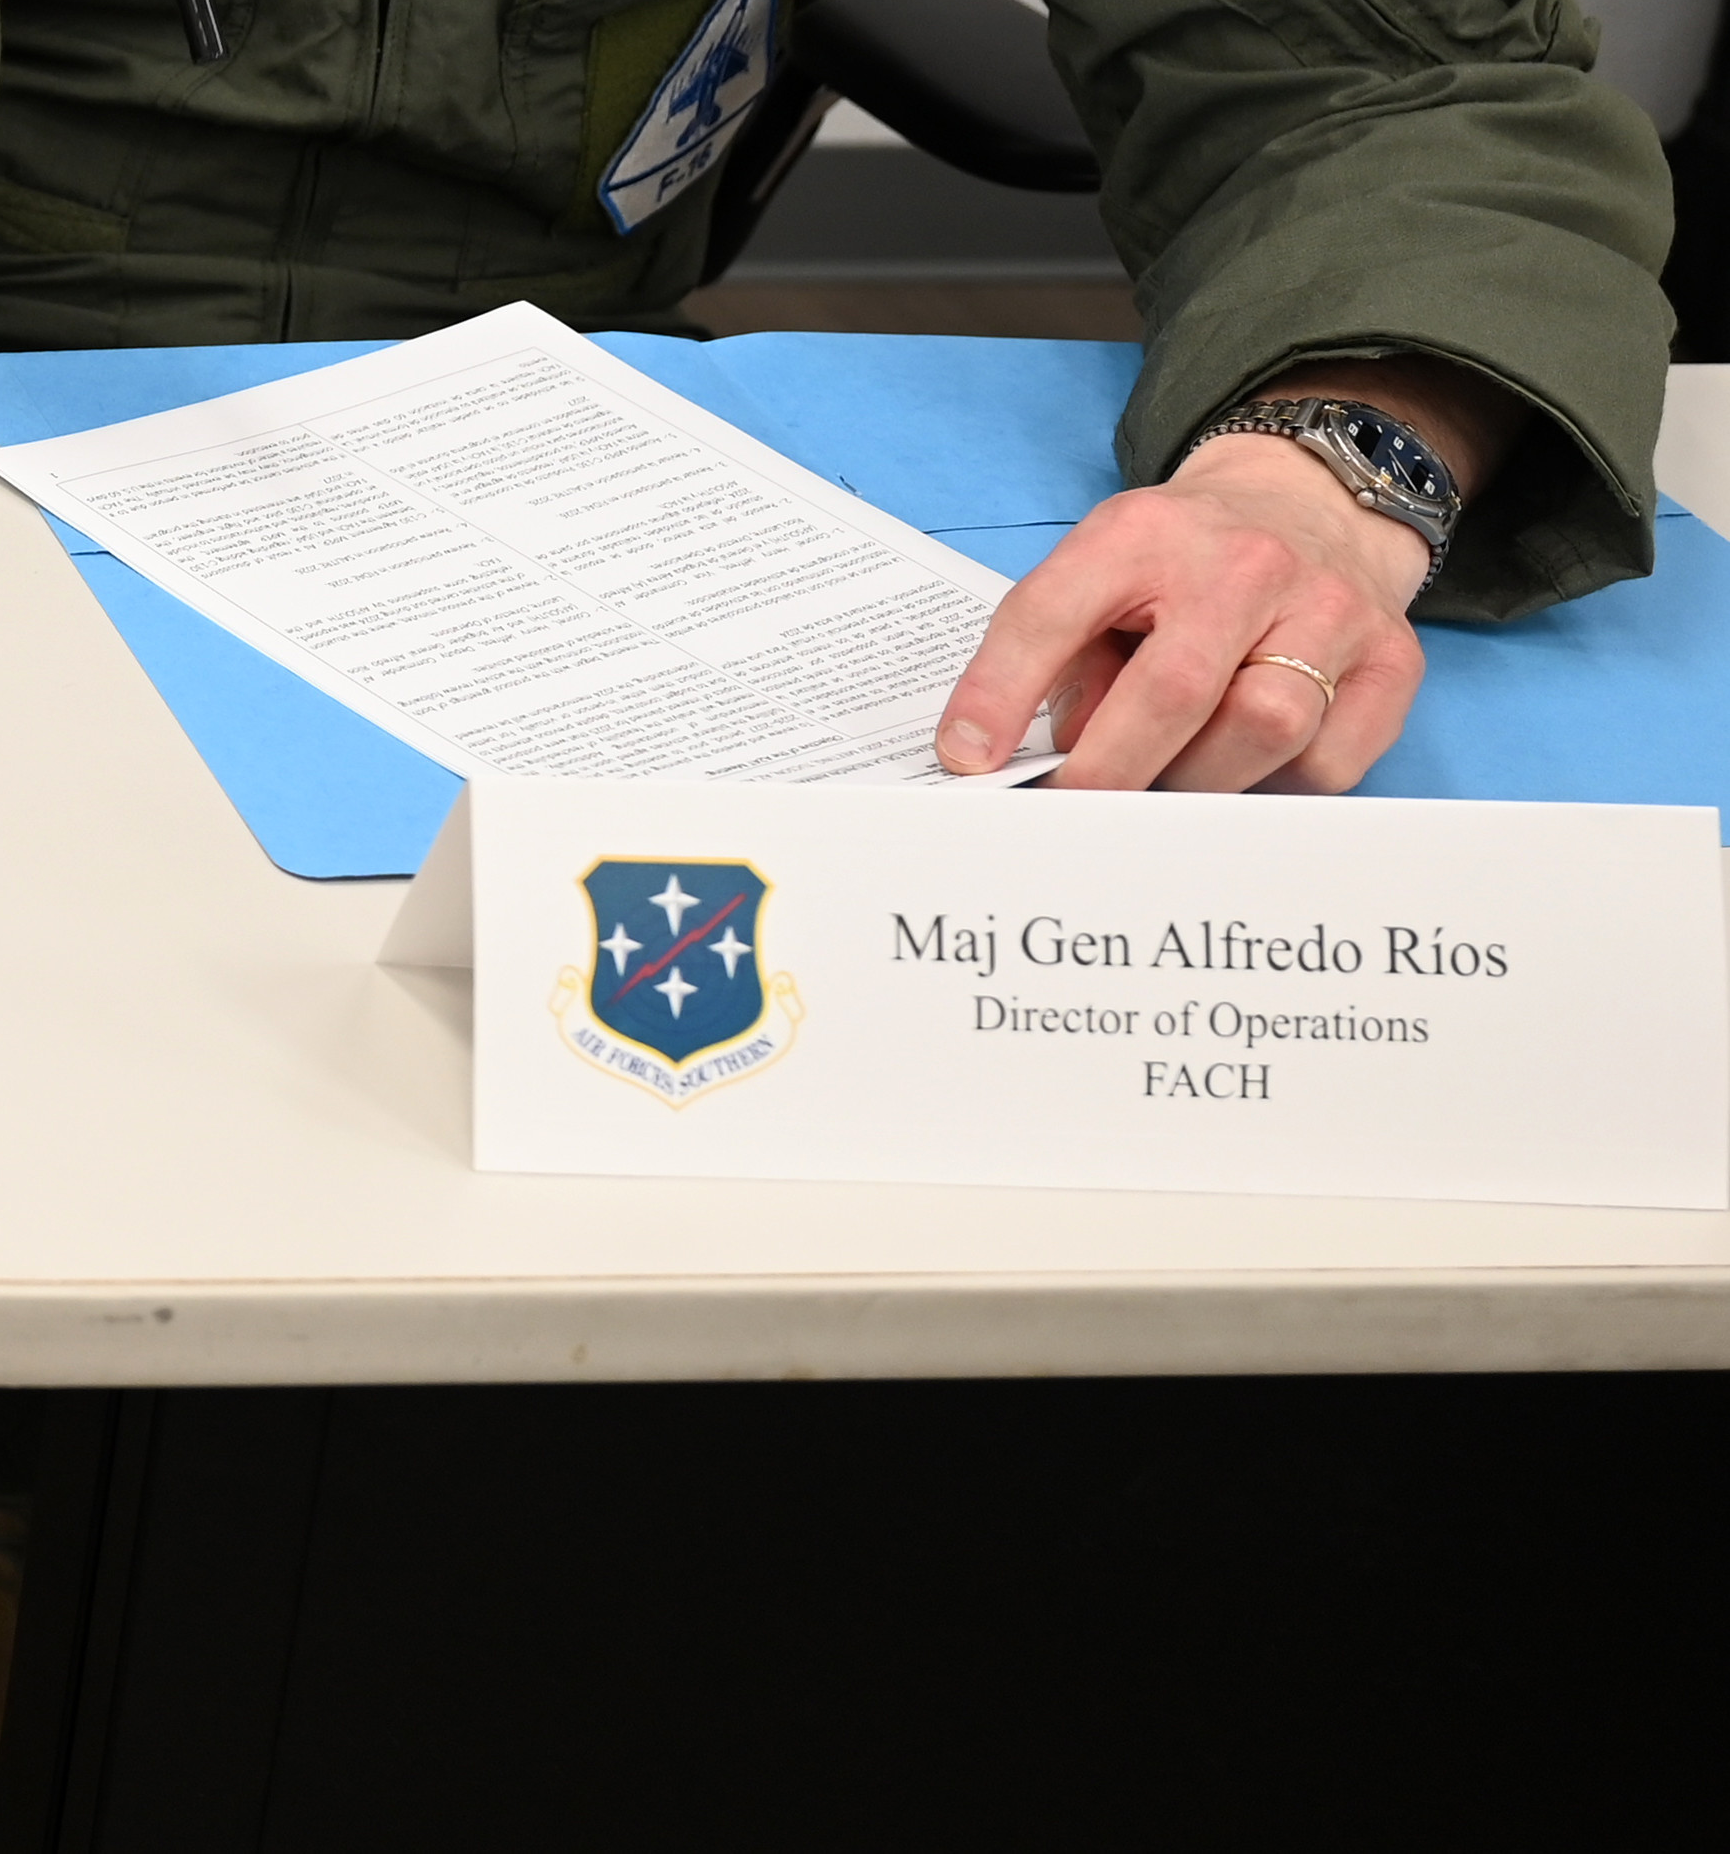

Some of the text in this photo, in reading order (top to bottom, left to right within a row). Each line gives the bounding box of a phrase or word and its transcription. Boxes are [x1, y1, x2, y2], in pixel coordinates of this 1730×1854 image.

[656, 142, 713, 203] F-16
[889, 912, 1510, 978] Maj Gen Alfredo Ríos
[972, 994, 1431, 1048] Director of Operations
[679, 1035, 775, 1096] SOUTHERN
[1142, 1060, 1273, 1101] FACH
